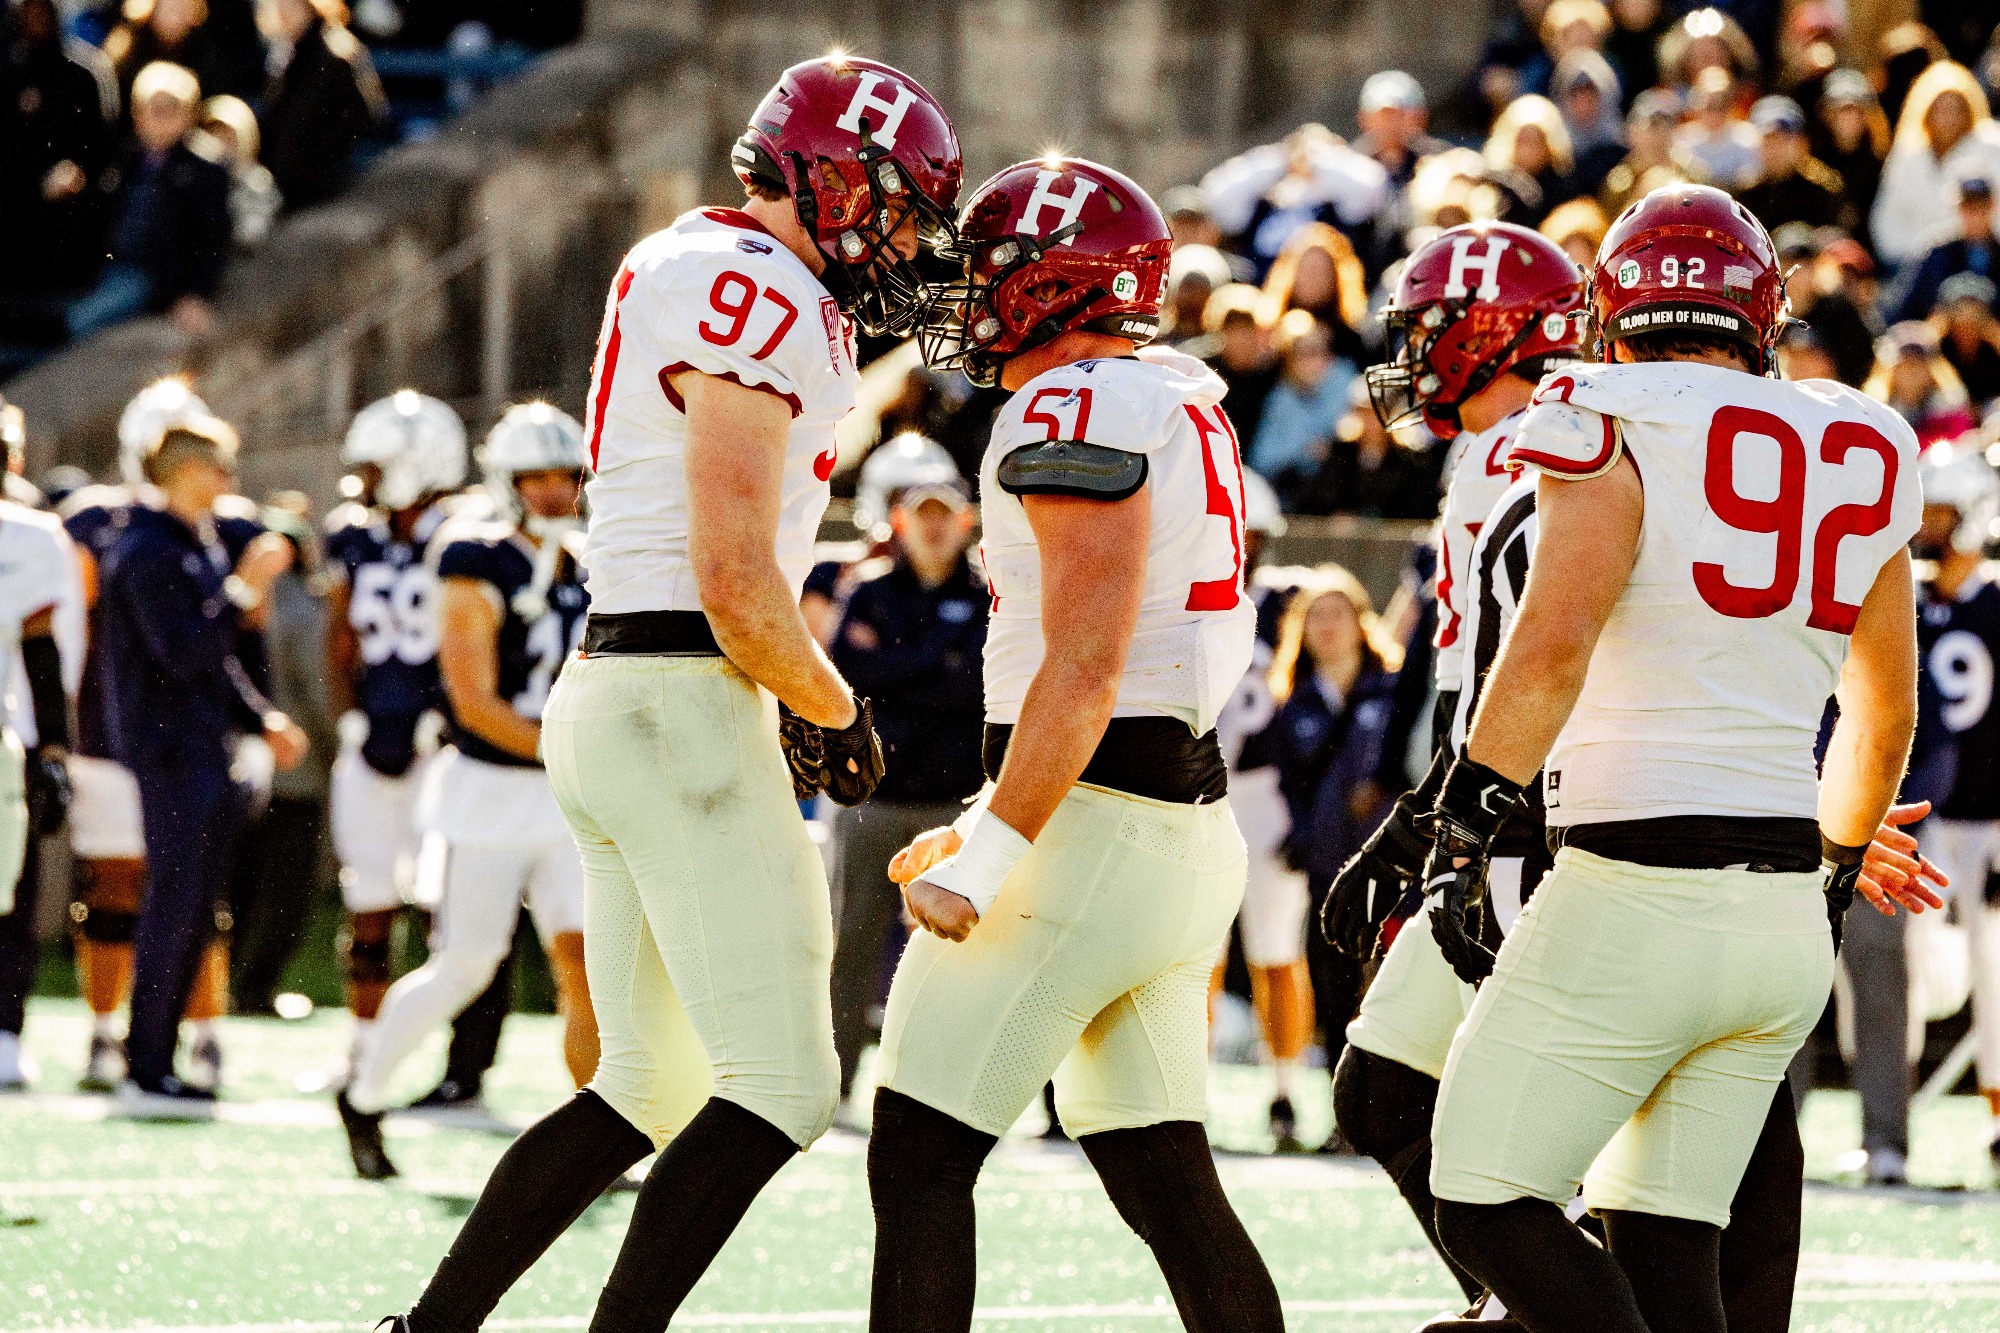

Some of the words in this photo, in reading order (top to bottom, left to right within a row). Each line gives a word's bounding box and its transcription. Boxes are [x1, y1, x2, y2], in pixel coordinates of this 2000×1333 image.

[836, 71, 918, 151] H
[1015, 170, 1099, 247] H
[1114, 277, 1136, 293] BT
[1444, 236, 1511, 303] H
[1621, 265, 1638, 284] BT
[1660, 257, 1706, 289] 92
[698, 270, 799, 361] 97
[1620, 313, 1650, 331] 10,000
[1652, 311, 1673, 323] MEN
[1676, 311, 1690, 324] OF
[1692, 312, 1739, 331] HARVARD
[1023, 387, 1094, 443] 51
[1692, 405, 1899, 636] 92
